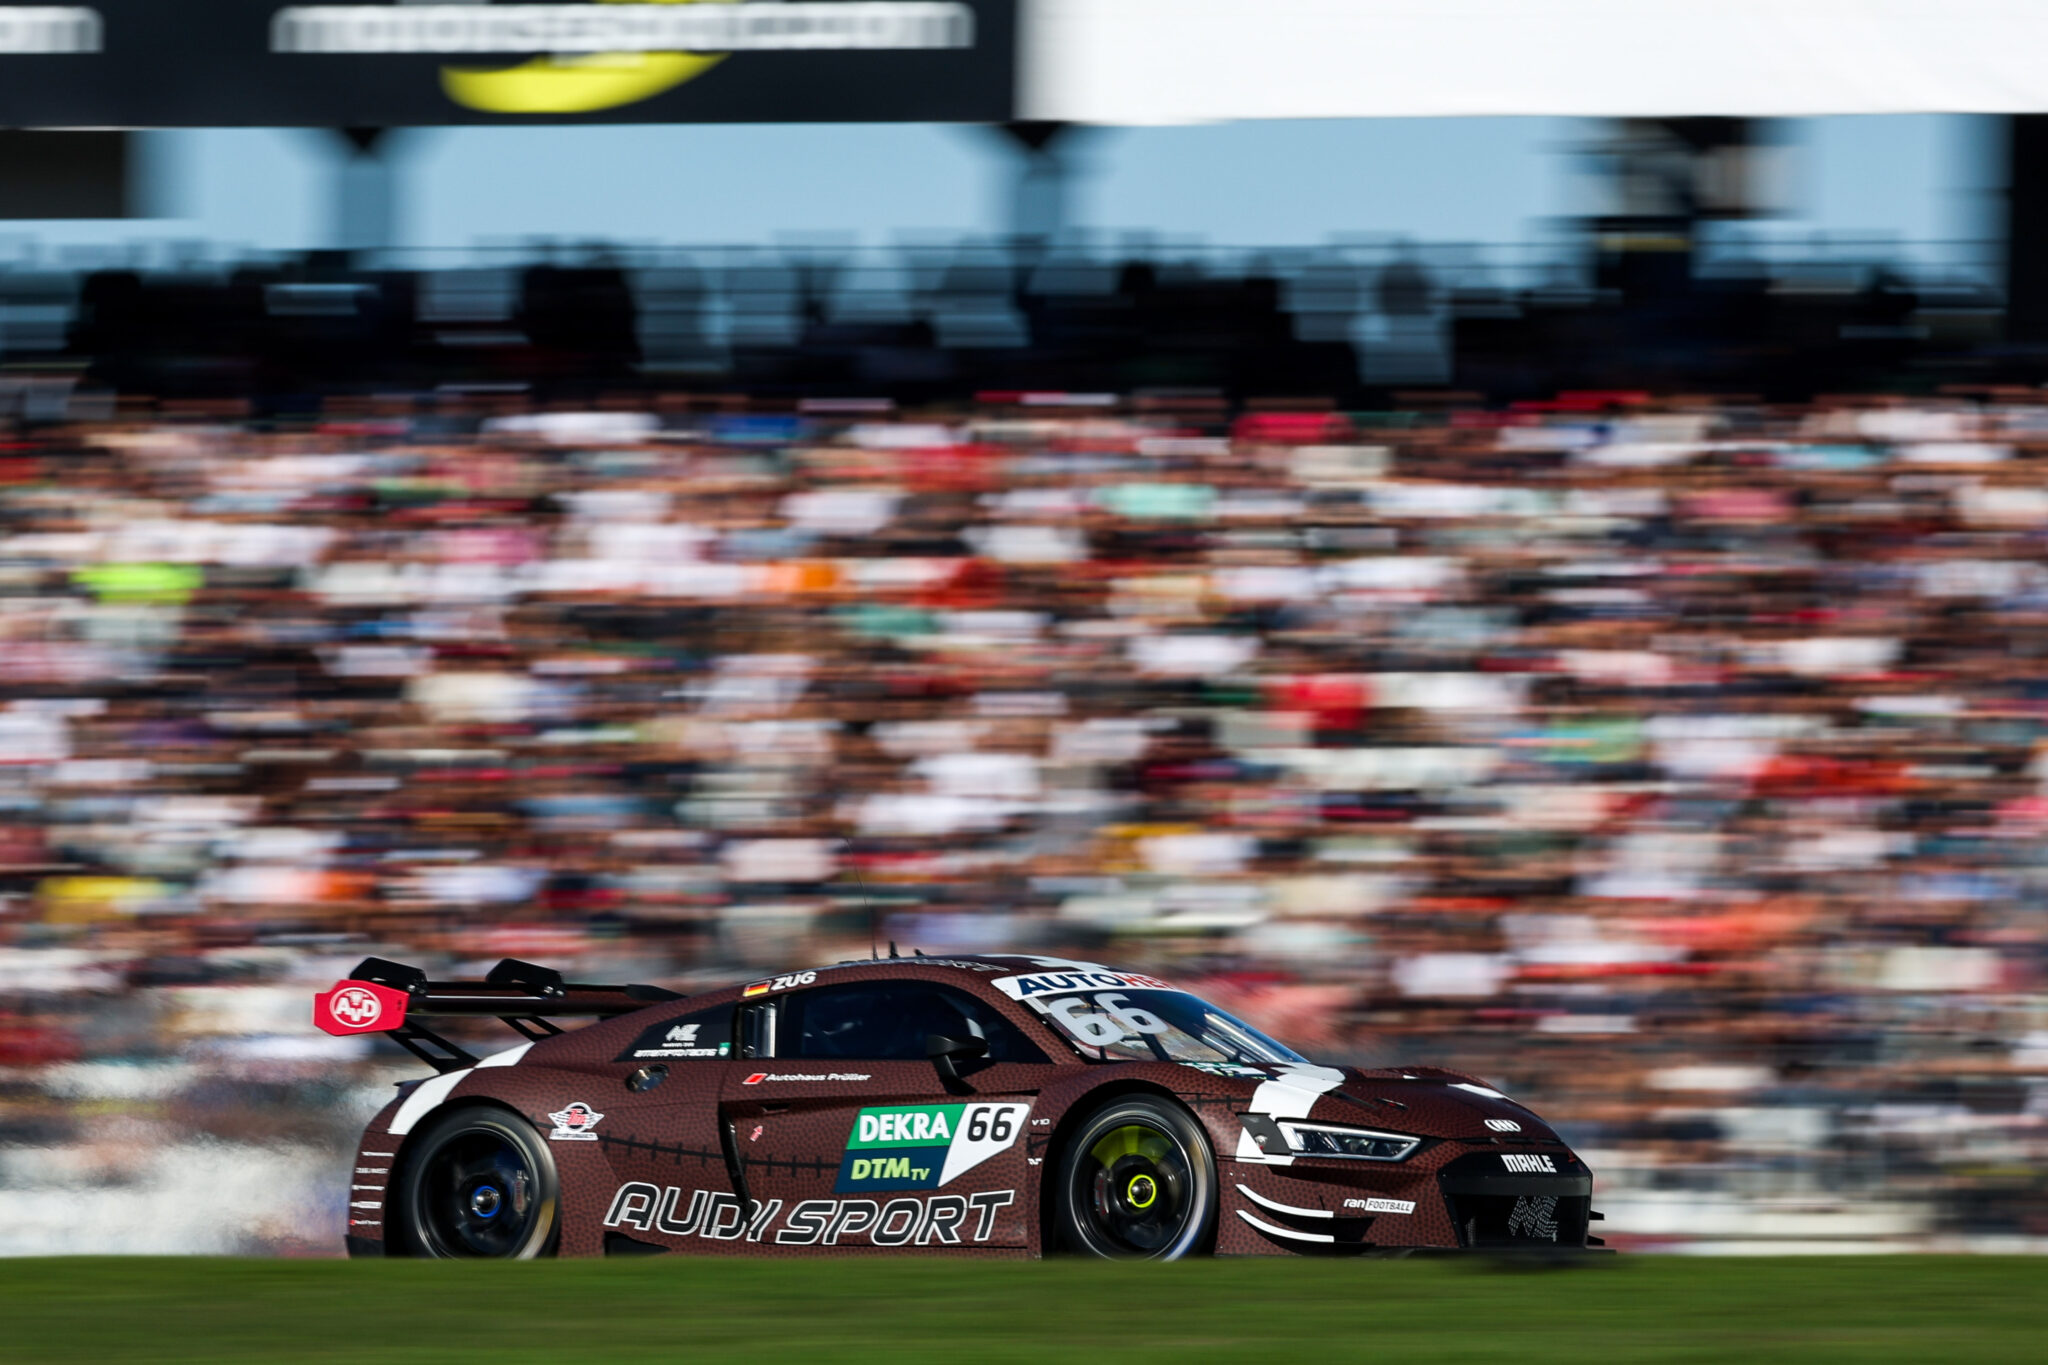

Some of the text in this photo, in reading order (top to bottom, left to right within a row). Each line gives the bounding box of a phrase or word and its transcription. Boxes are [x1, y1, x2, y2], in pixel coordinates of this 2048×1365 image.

[770, 971, 817, 991] ZUG
[1048, 993, 1168, 1047] 66
[765, 1073, 826, 1082] Autohaus
[859, 1112, 951, 1142] DEKRA
[967, 1107, 1016, 1142] 66
[850, 1157, 931, 1181] DTM TV
[1500, 1154, 1558, 1173] MAHLE
[602, 1180, 1016, 1246] AUDI SPORT
[1342, 1198, 1411, 1213] ran FOOTBALL
